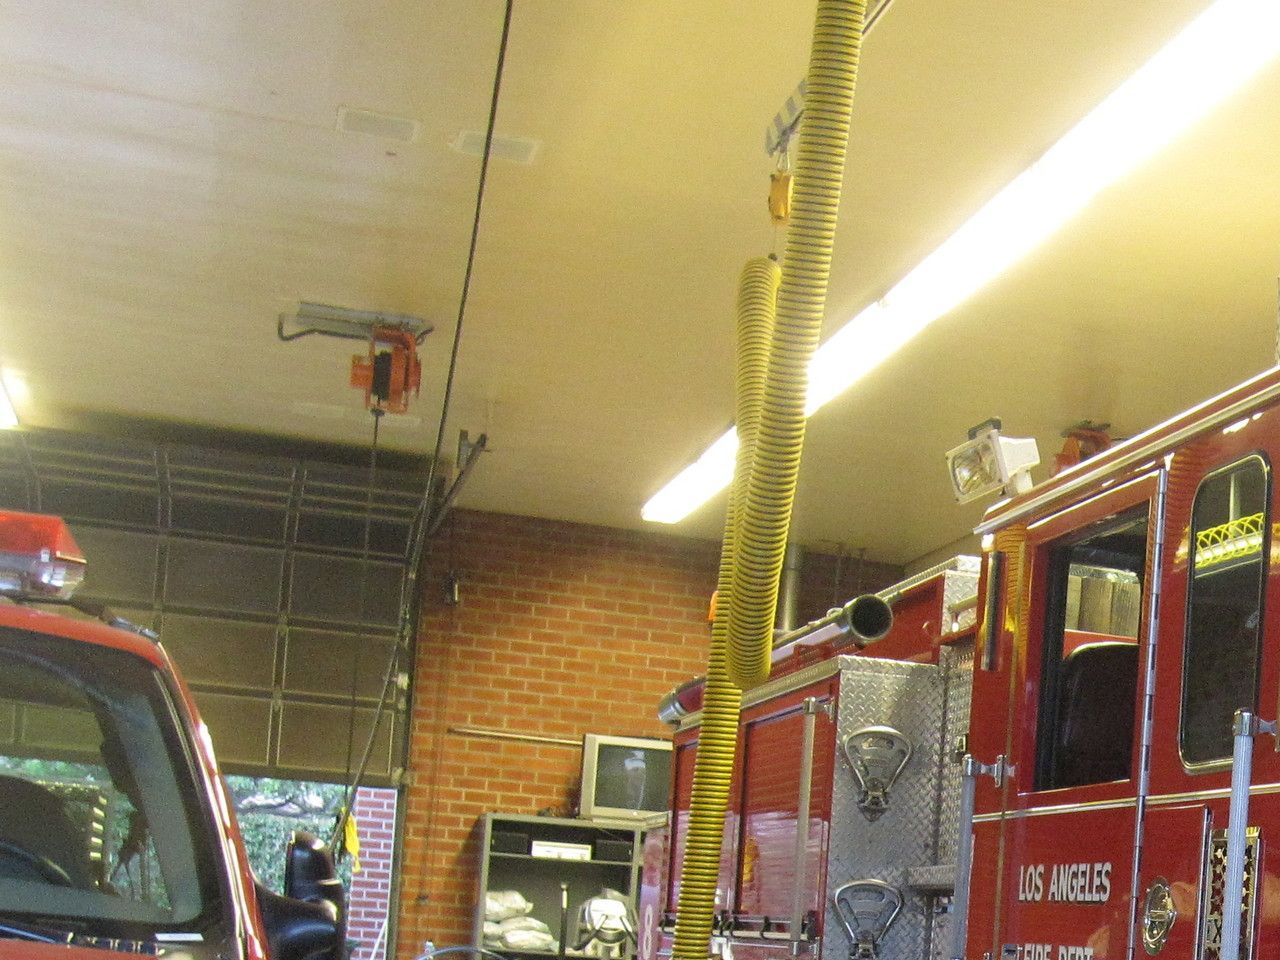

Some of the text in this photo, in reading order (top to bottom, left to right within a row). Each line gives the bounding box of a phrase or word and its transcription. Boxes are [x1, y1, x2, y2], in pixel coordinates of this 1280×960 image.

[1018, 862, 1112, 904] LOS ANGELES
[643, 904, 653, 960] 8
